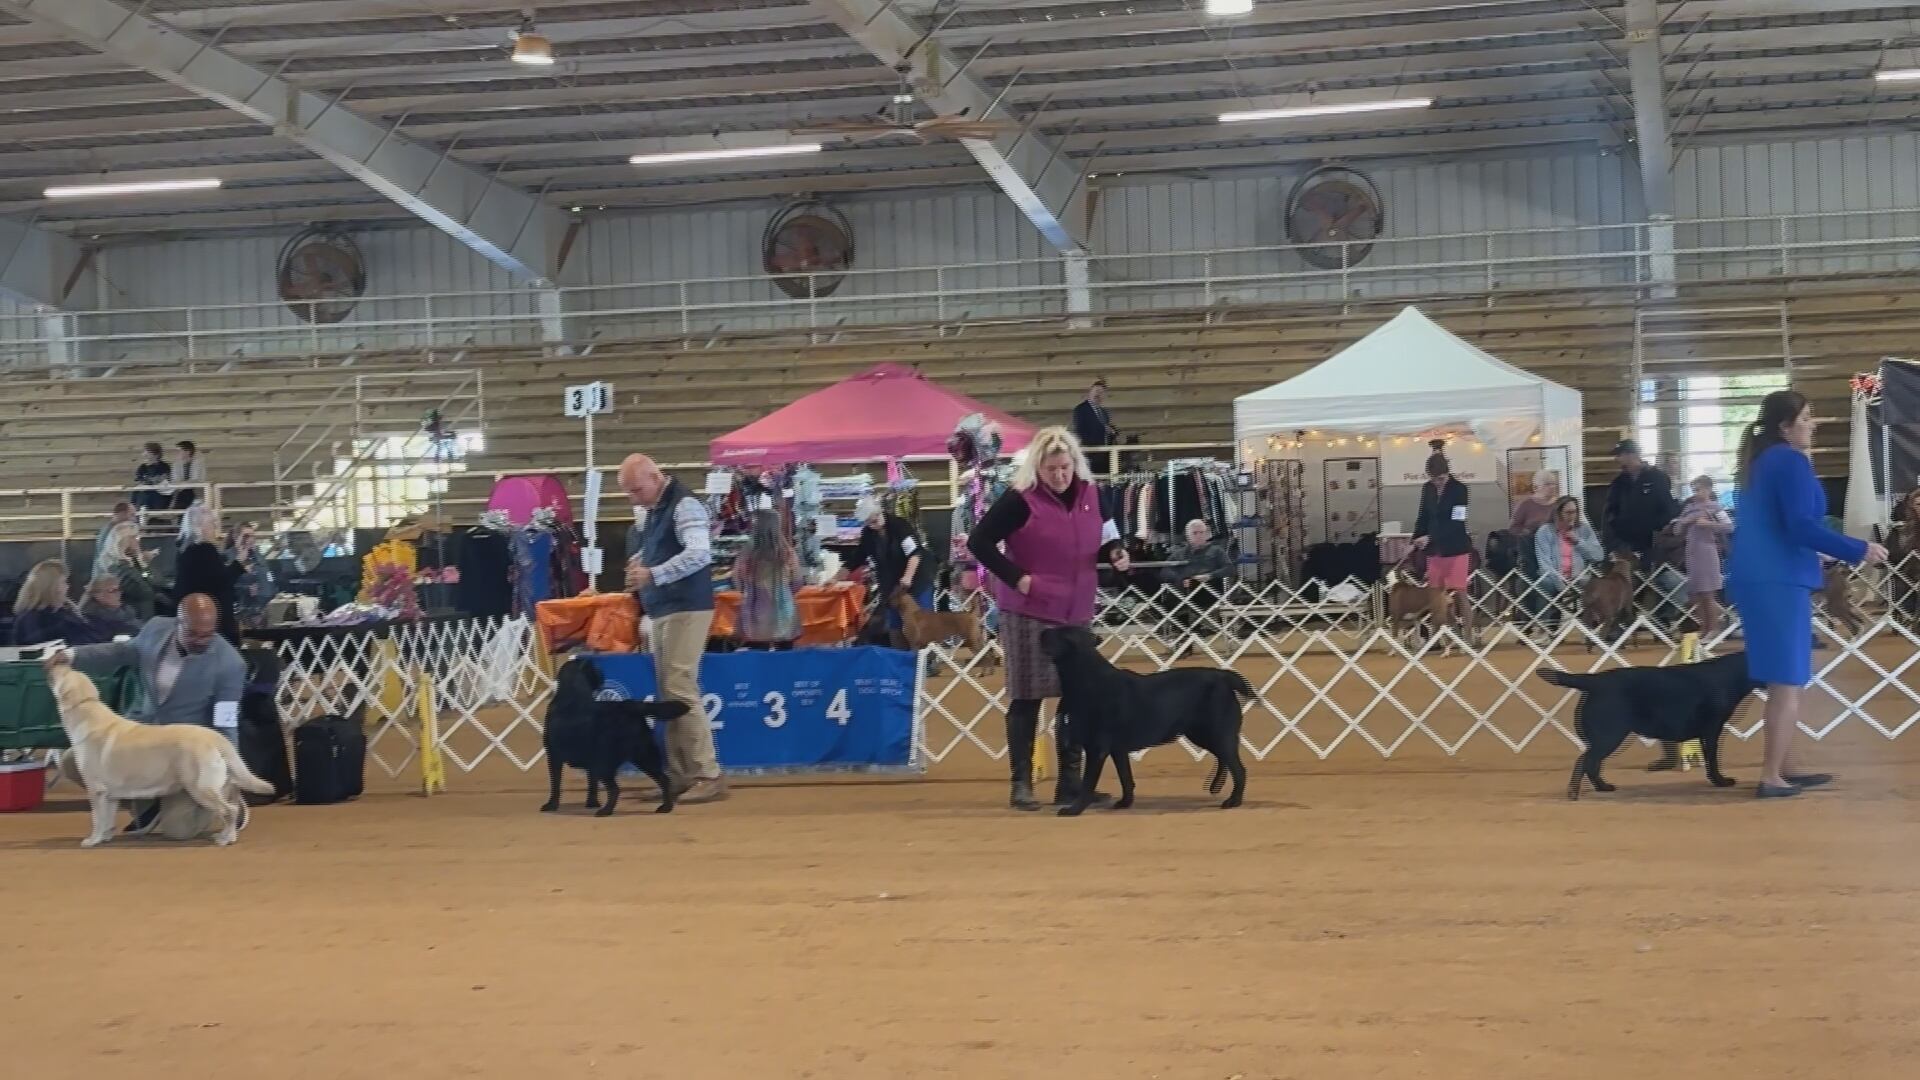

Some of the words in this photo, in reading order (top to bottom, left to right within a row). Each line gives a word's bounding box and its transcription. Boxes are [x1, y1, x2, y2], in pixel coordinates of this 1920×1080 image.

[573, 390, 583, 410] 3
[701, 693, 724, 729] 2
[763, 691, 788, 728] 3
[826, 689, 852, 726] 4
